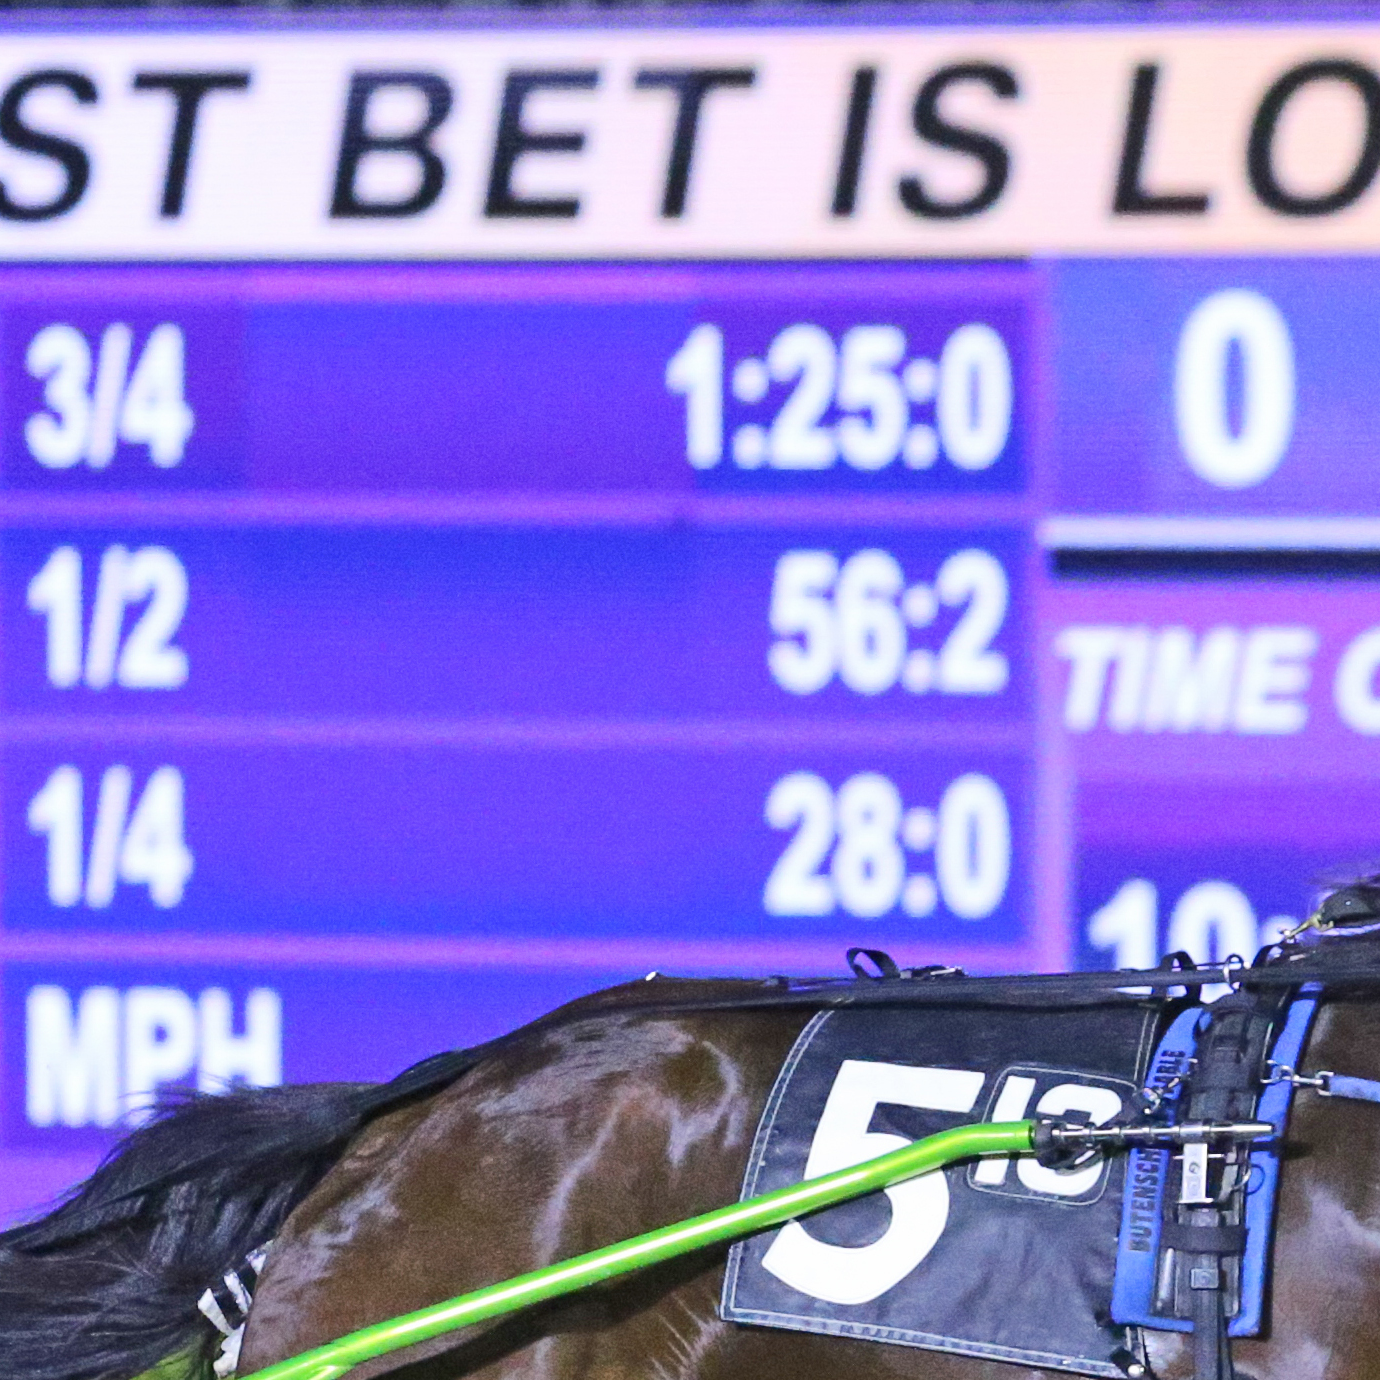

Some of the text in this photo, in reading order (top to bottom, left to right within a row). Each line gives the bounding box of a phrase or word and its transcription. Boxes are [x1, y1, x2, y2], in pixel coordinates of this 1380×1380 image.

[328, 65, 757, 220] BET
[830, 60, 1020, 222] IS
[25, 323, 1013, 470] 3/4 1:25:0
[1174, 288, 1296, 488] 0
[27, 545, 1009, 695] 1/2 56:2
[1055, 625, 1318, 735] TIME
[28, 766, 1012, 919] 1/4 28:0
[26, 984, 283, 1127] MPH
[762, 1059, 987, 1305] 5
